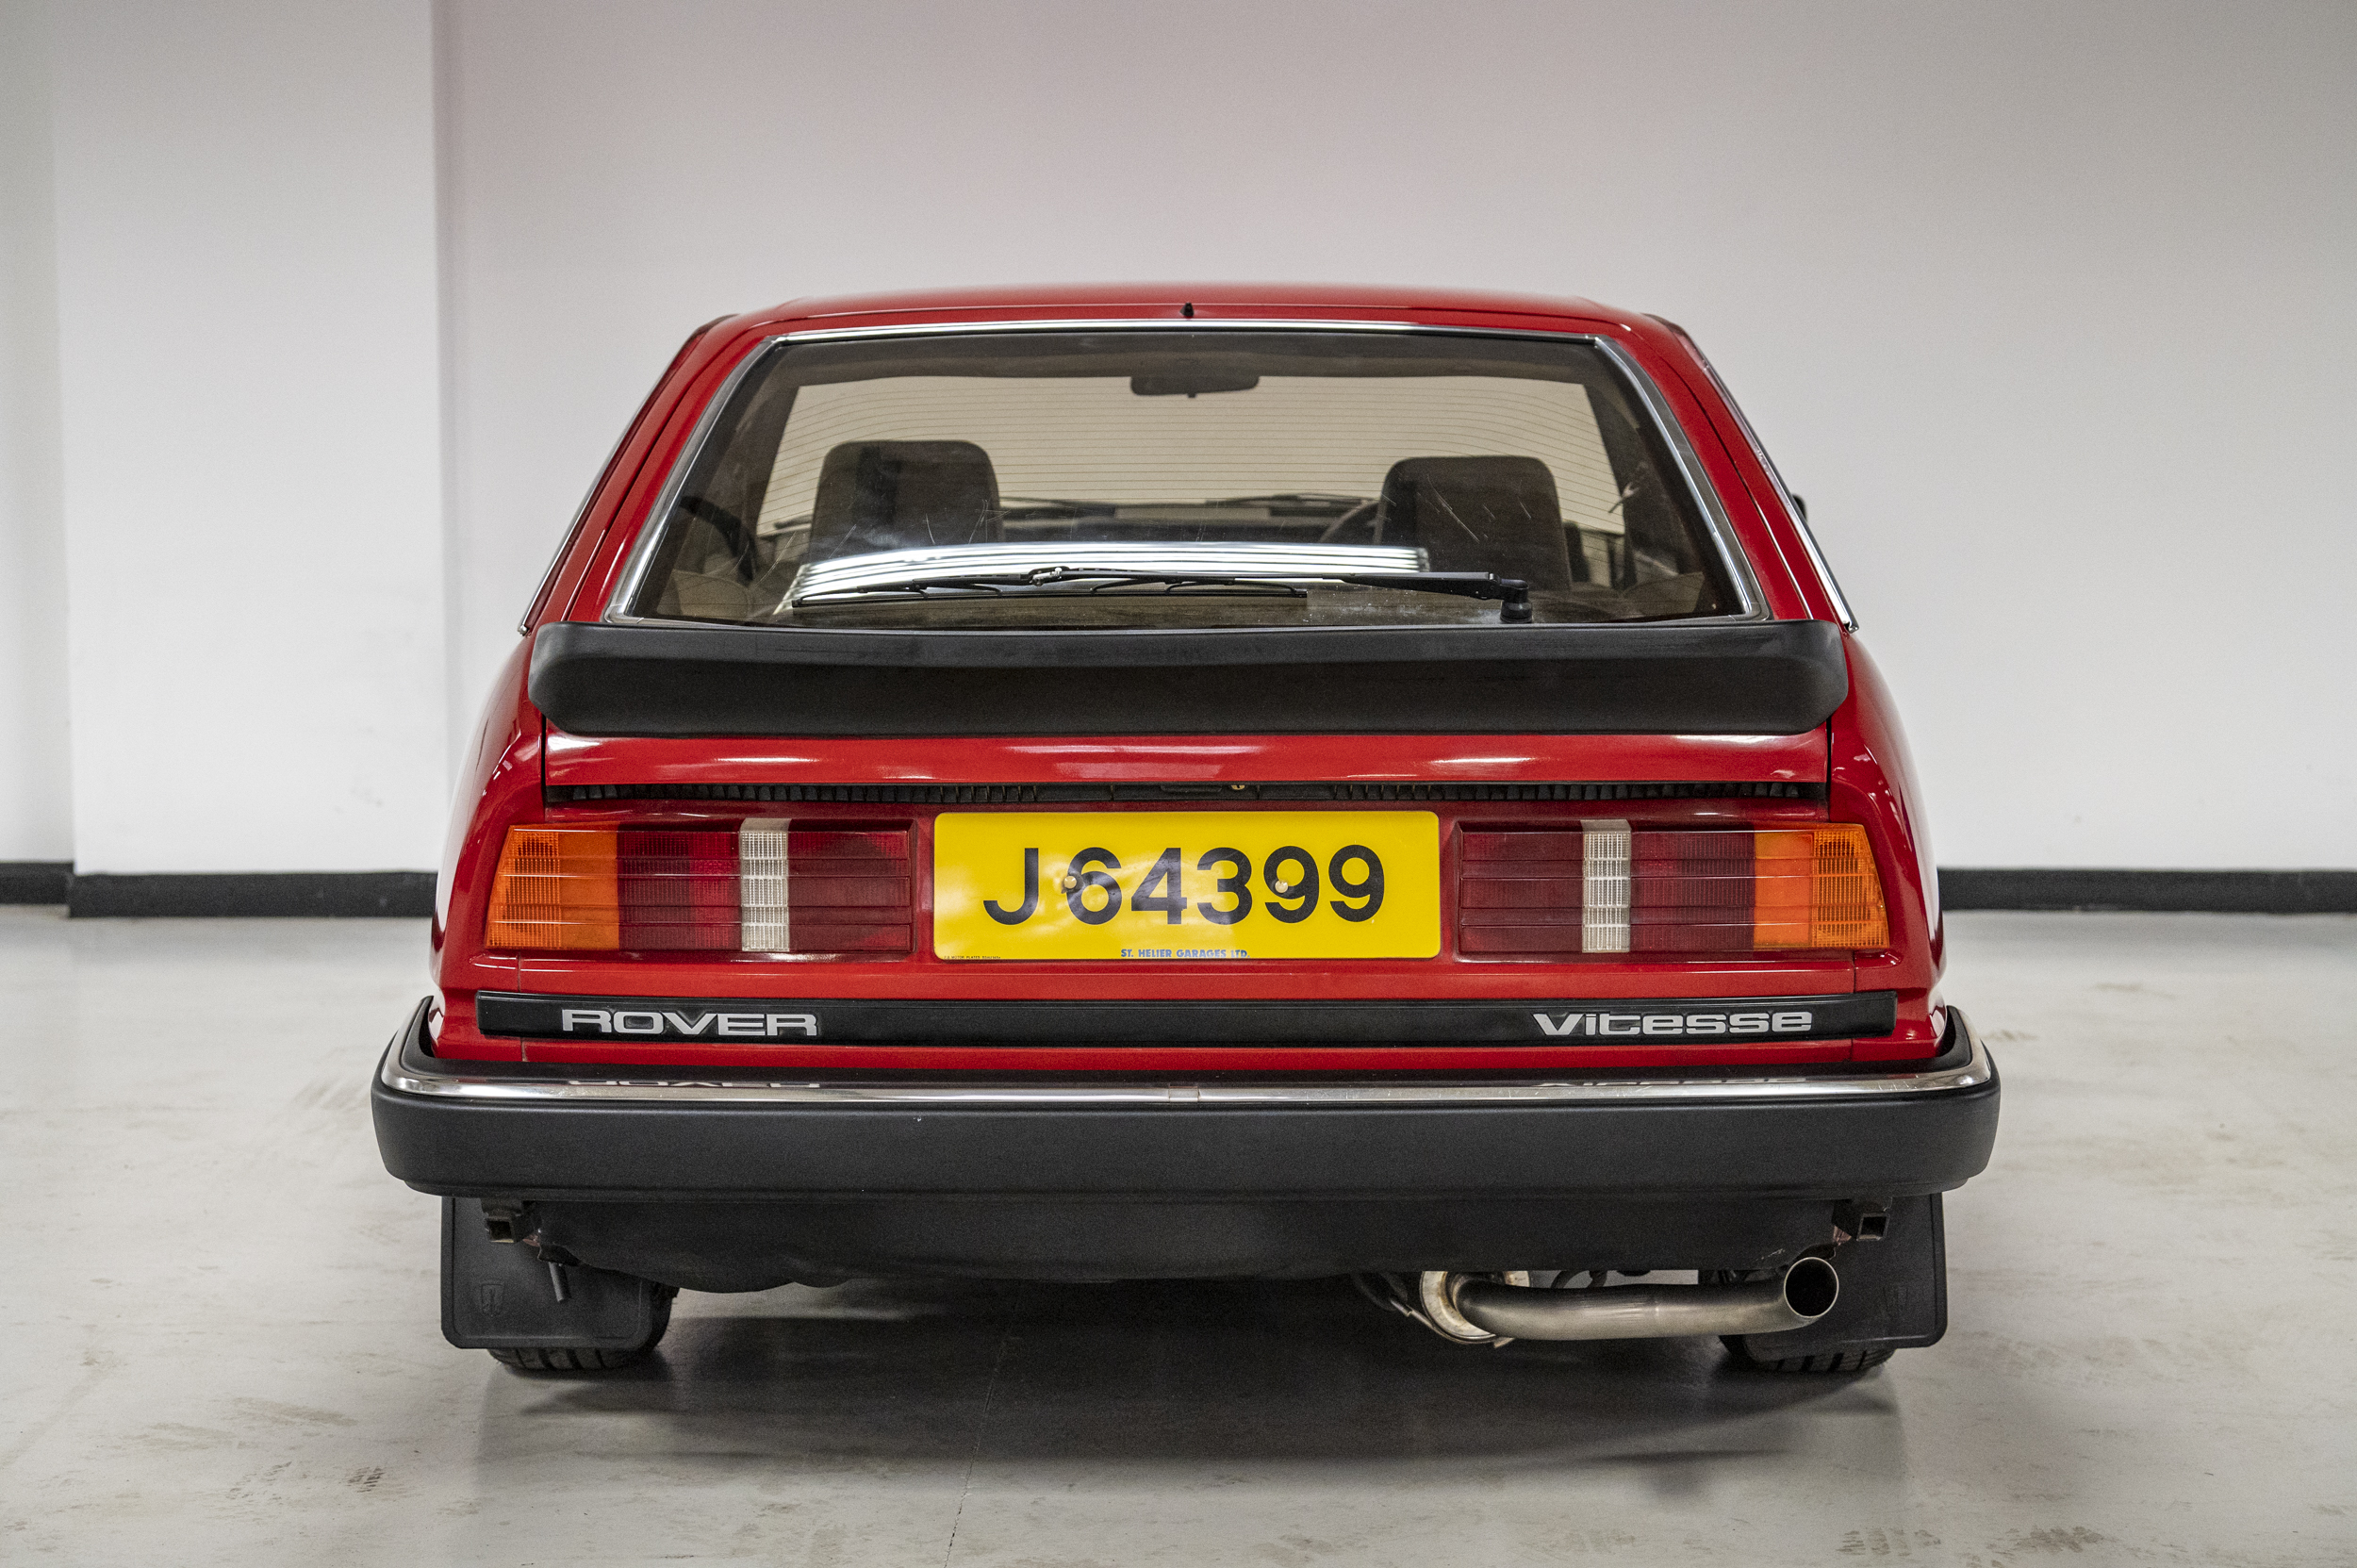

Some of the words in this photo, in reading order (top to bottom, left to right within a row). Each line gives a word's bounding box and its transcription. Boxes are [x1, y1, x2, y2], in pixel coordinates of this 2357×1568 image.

[1120, 949, 1134, 958] ST.
[1138, 949, 1172, 958] HELIER
[1176, 949, 1227, 958] GARAGES
[1230, 949, 1250, 958] LTD.
[562, 1009, 818, 1036] ROVER
[1533, 1012, 1812, 1036] Vitesse
